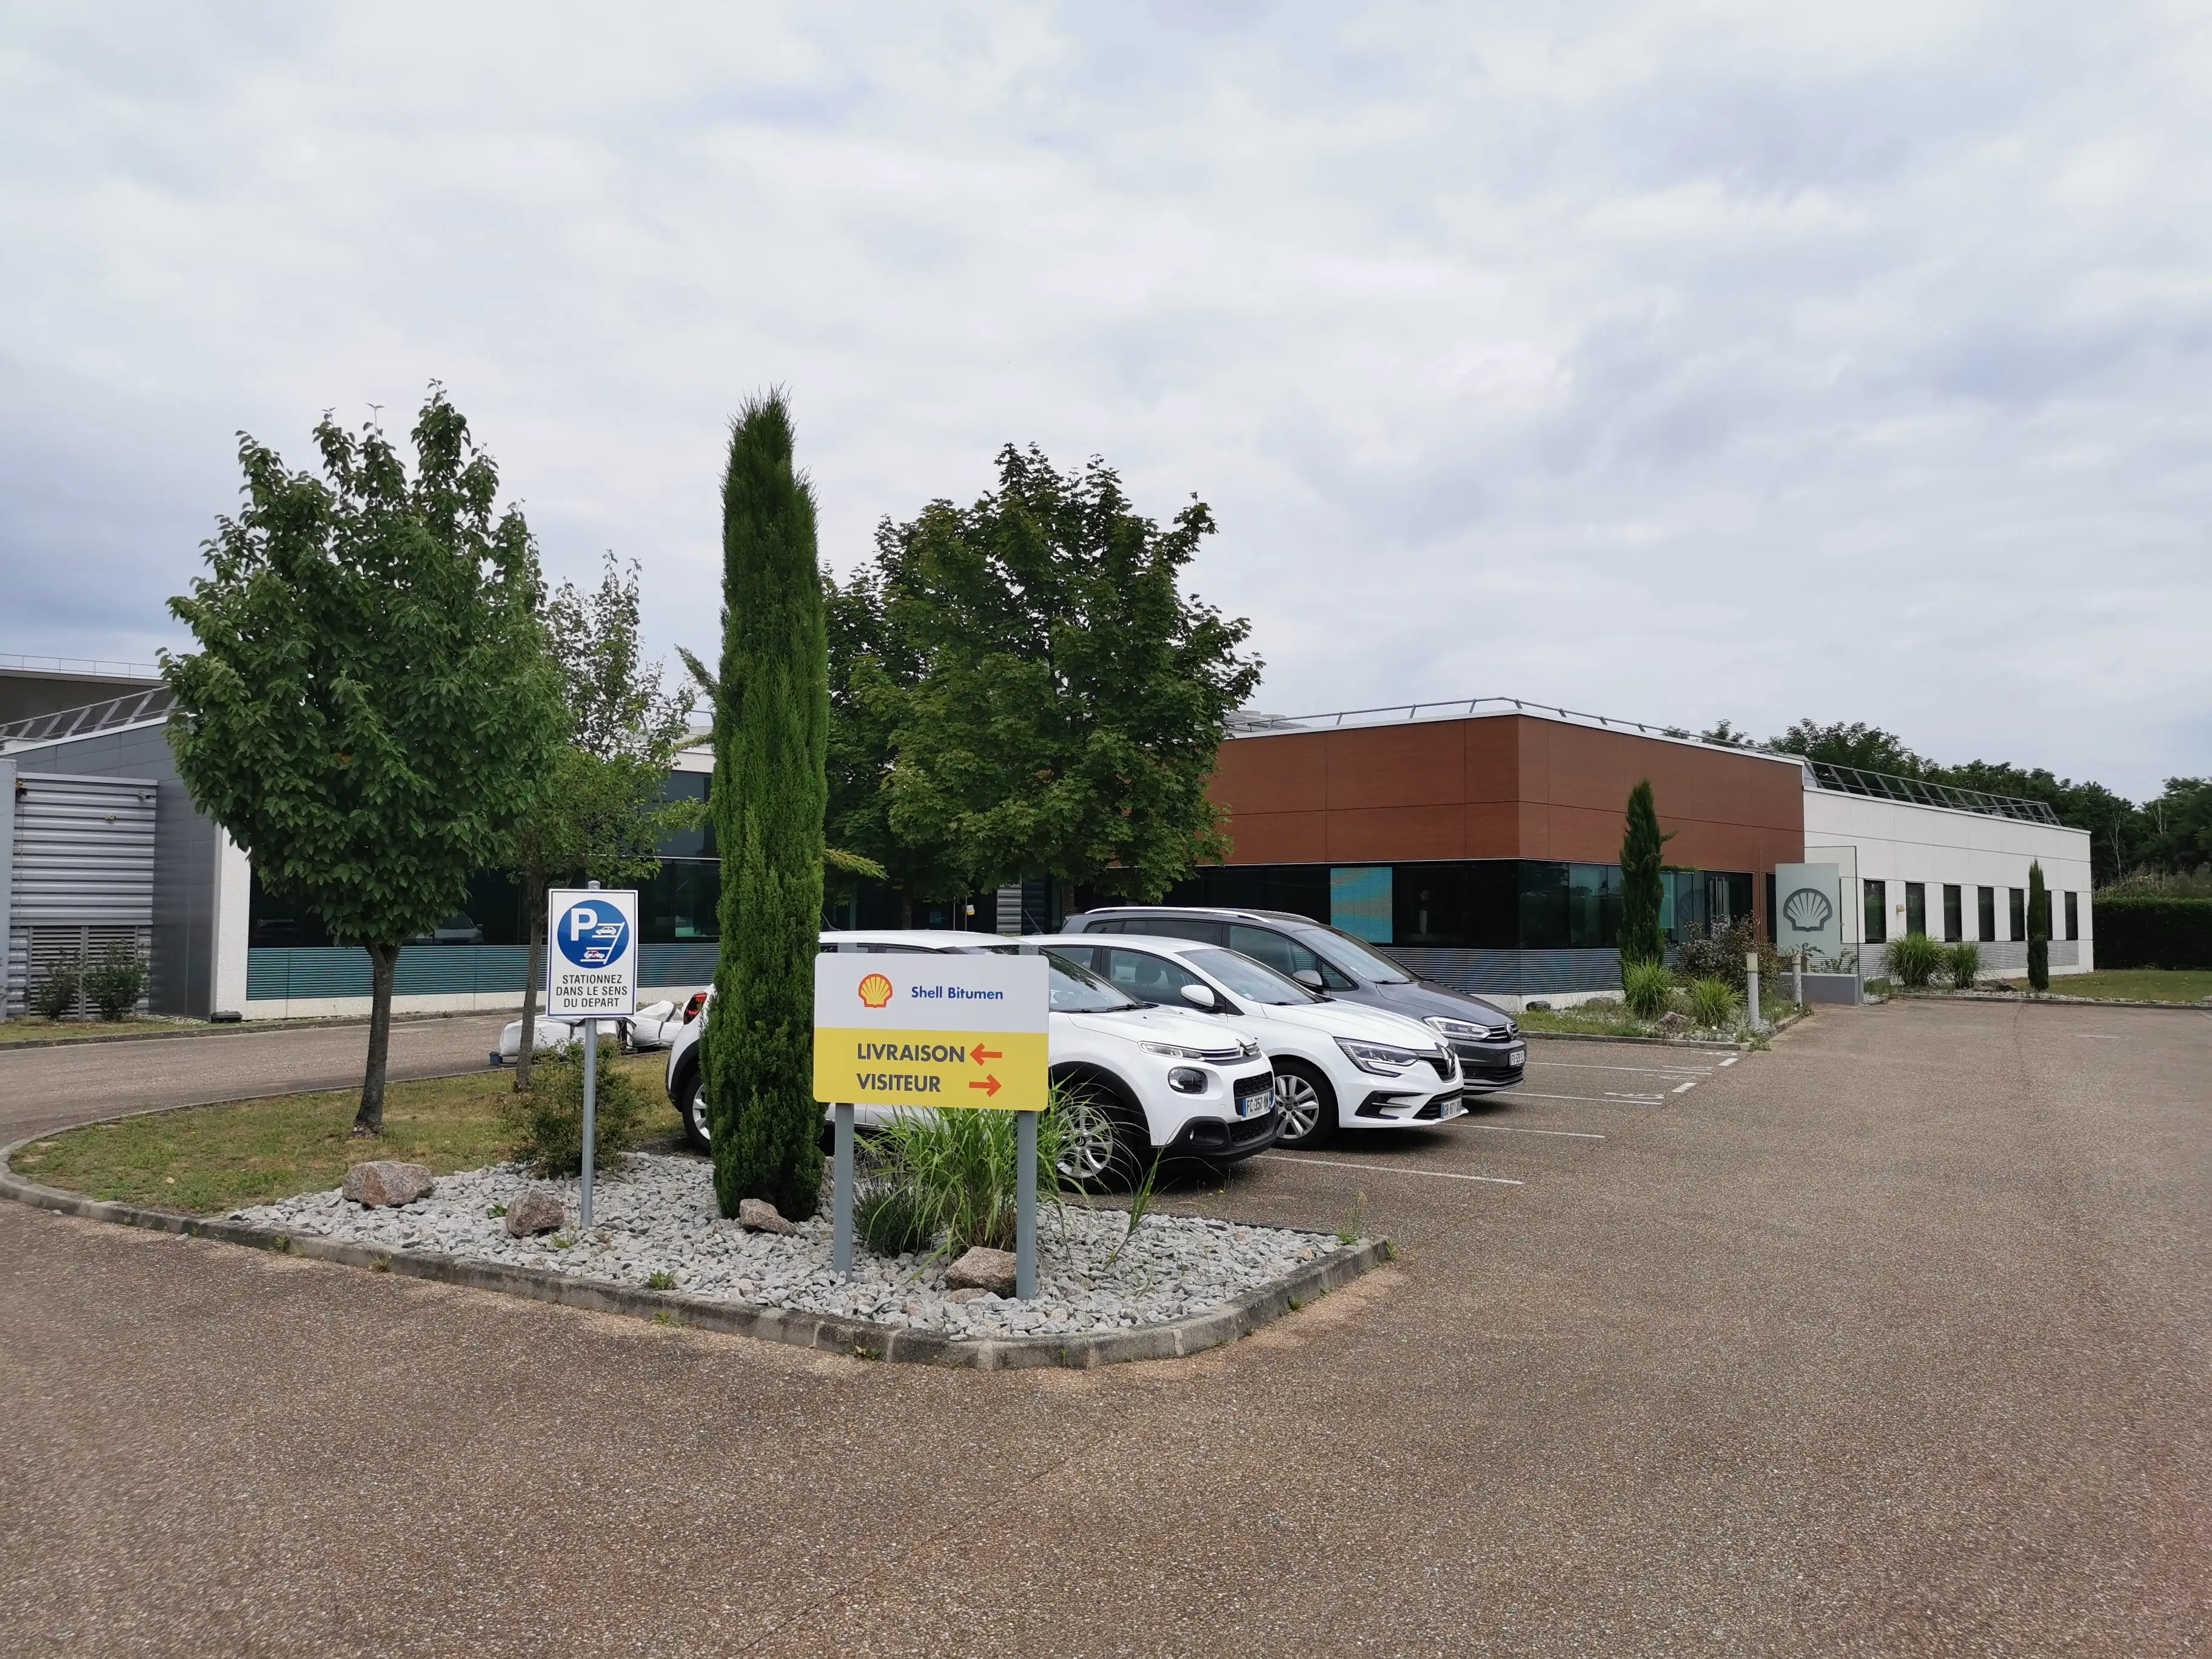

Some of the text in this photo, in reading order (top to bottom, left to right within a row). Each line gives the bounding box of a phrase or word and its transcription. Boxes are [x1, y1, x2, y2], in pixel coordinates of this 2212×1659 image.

[571, 908, 598, 941] P
[563, 974, 623, 984] STATIONNEZ
[556, 986, 628, 996] DANS LE SENS
[911, 986, 1004, 1000] Shell Bitumen
[564, 997, 620, 1008] DU DEPART
[857, 1043, 965, 1063] LIVRAISON
[856, 1073, 942, 1093] VISITEUR
